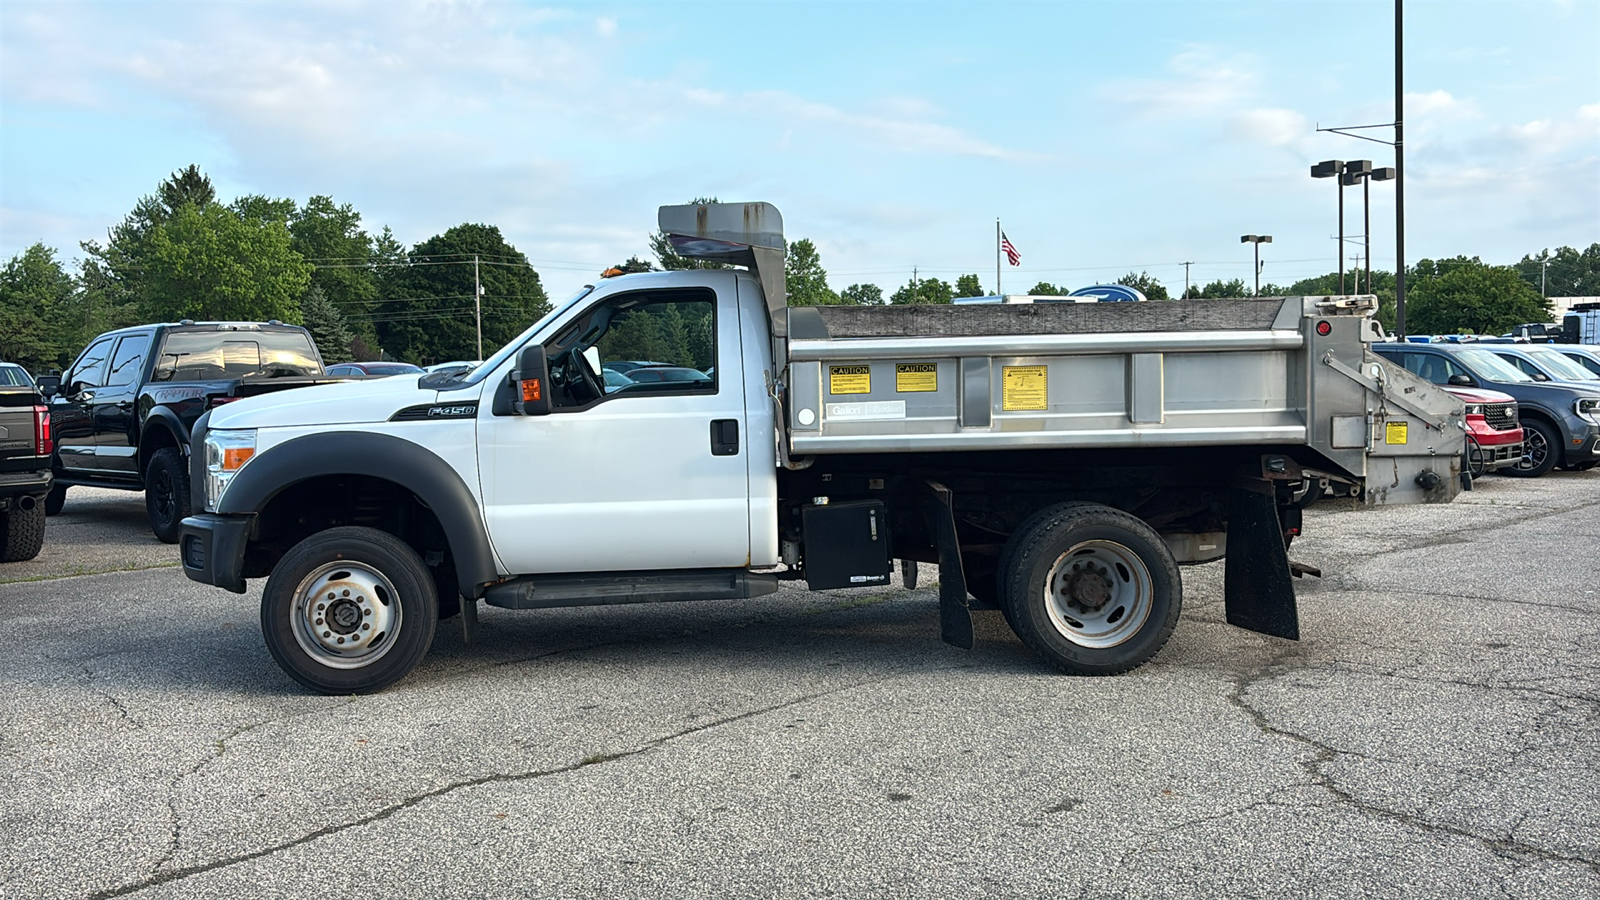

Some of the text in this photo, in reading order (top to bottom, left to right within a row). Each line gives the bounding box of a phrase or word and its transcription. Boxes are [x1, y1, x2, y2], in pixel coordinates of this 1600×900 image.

[832, 367, 868, 375] CAUTION
[898, 365, 935, 373] CAUTION
[161, 389, 204, 400] RAPTOR
[832, 406, 861, 416] Galion
